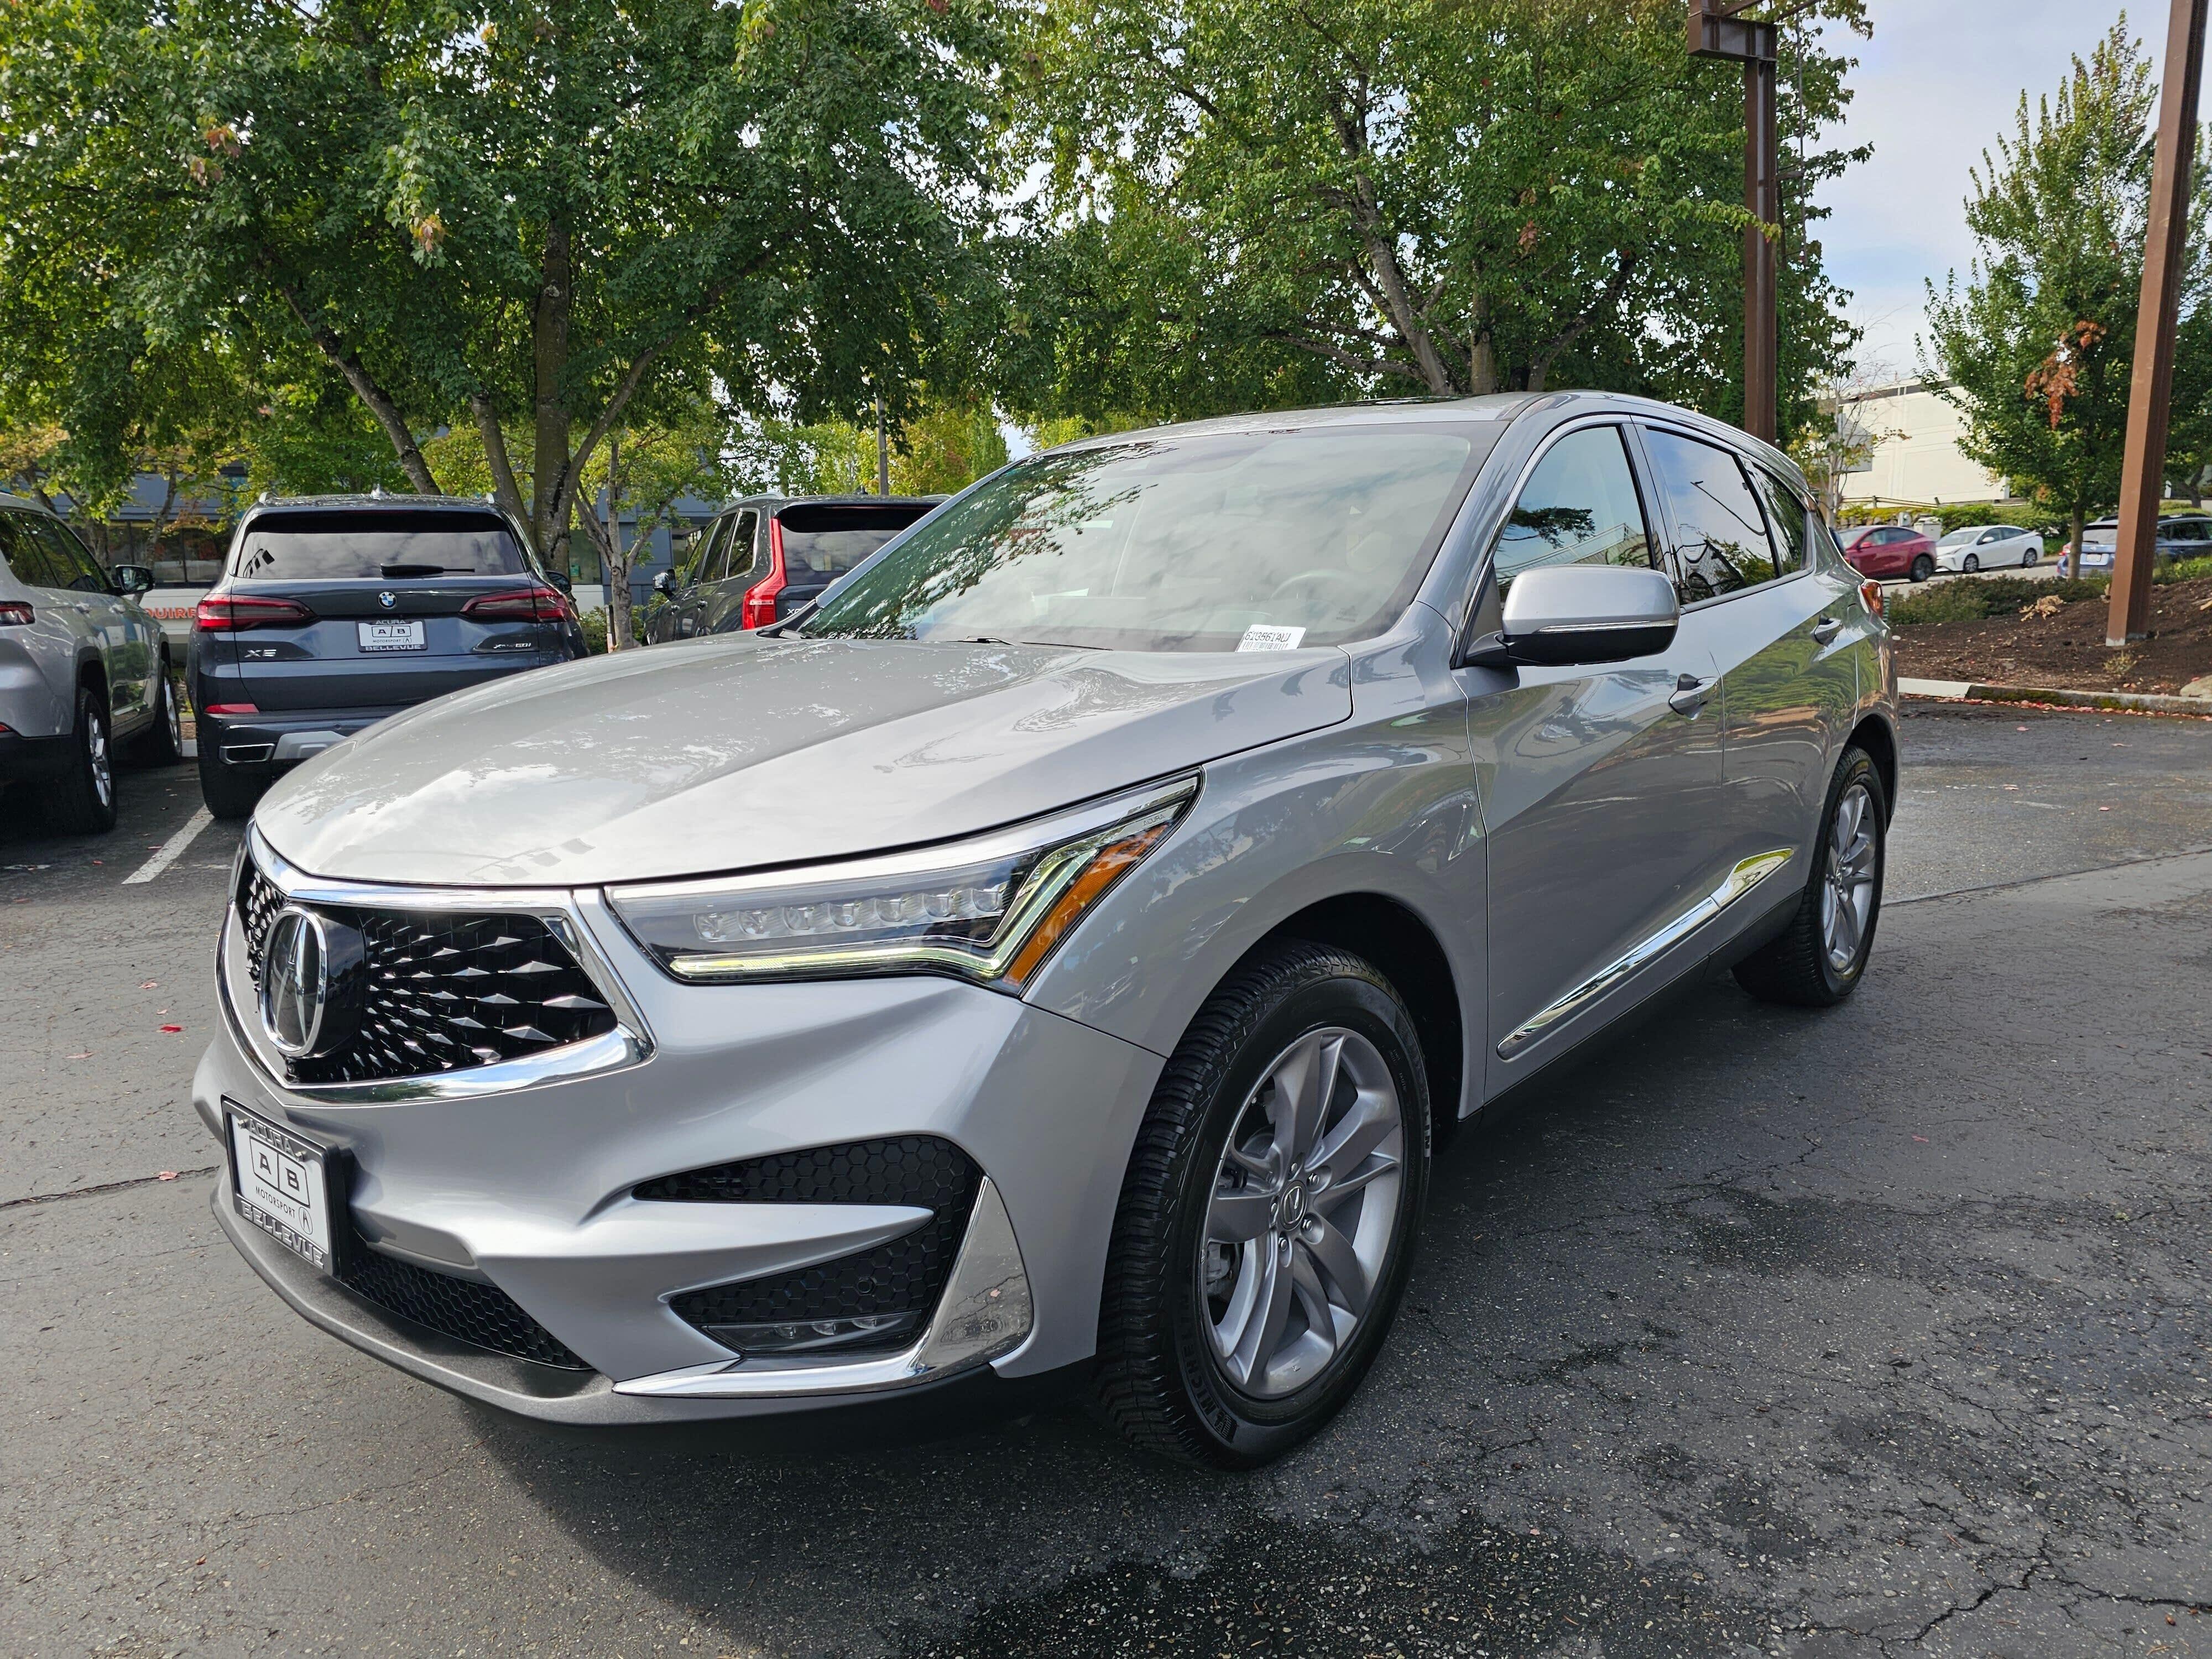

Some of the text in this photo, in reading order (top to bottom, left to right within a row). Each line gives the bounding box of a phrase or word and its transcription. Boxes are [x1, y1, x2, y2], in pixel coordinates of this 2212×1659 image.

[244, 649, 277, 658] X5
[1144, 814, 1165, 826] ACURA
[248, 1118, 295, 1157] ACURA
[255, 1186, 296, 1219] MOTORSPORT
[241, 1200, 324, 1270] BELLEVUE
